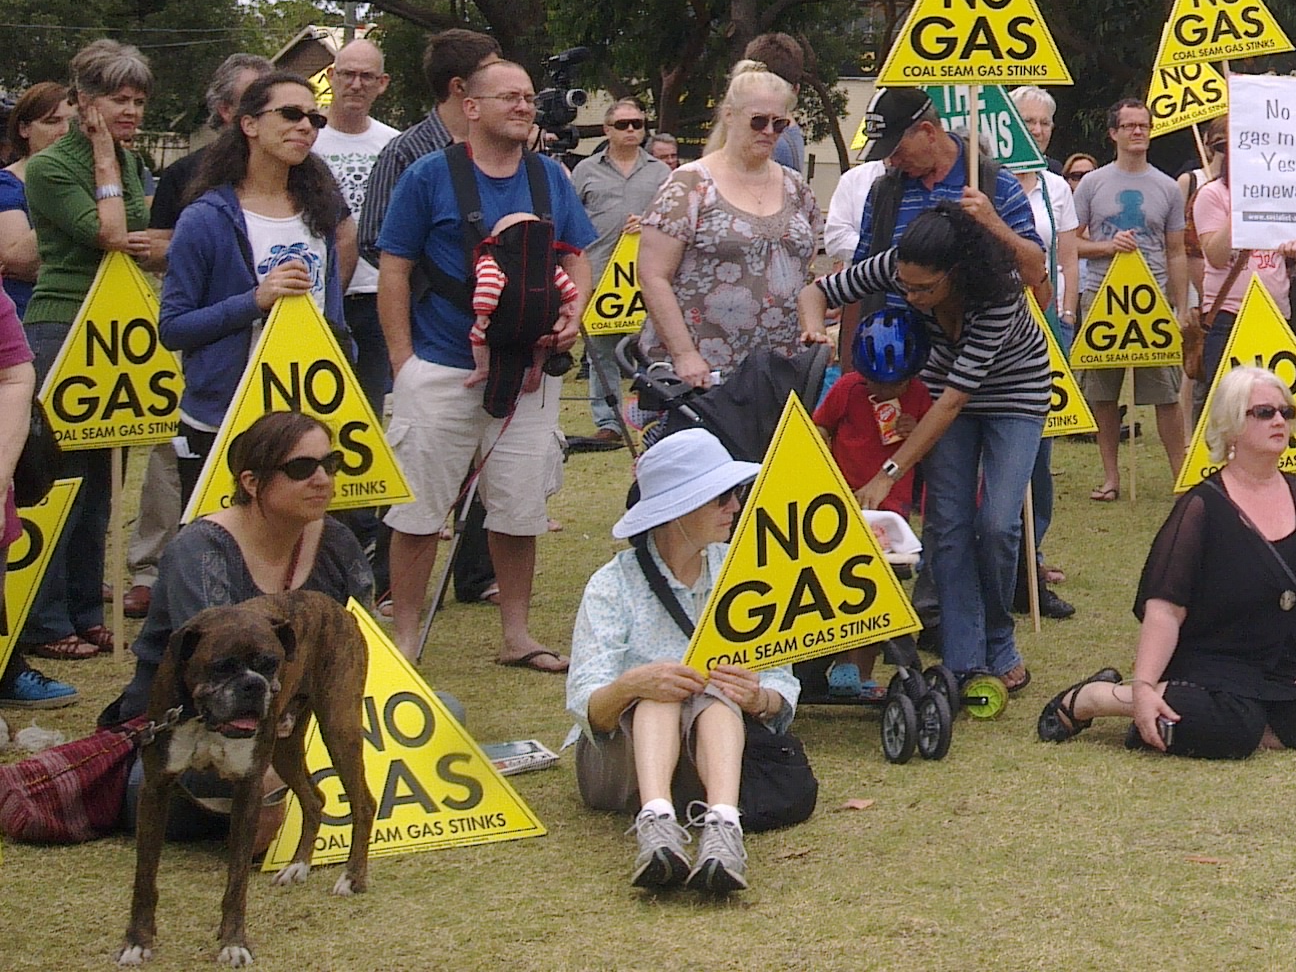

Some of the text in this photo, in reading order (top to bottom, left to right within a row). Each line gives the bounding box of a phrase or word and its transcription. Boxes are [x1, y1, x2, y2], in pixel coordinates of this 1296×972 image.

[910, 16, 1037, 61] GAS
[1174, 6, 1265, 47] GAS
[1172, 39, 1276, 61] COAL SEAM GAS STINKS
[903, 64, 1047, 77] COAL SEAM GAS STINKS
[1160, 63, 1202, 89] NO
[1150, 79, 1222, 119] GAS
[1266, 99, 1290, 120] No
[1191, 108, 1208, 119] GAS
[1237, 130, 1270, 150] gas
[1261, 152, 1296, 173] Yes
[613, 261, 635, 288] N
[595, 291, 648, 319] GA
[1106, 284, 1157, 315] NO
[591, 320, 613, 330] COAL
[614, 318, 635, 328] SEAM
[1085, 318, 1173, 351] GAS
[86, 318, 157, 367] NO
[1080, 351, 1181, 364] COAL SEAM GAS STINKS
[52, 370, 178, 424] GAS
[261, 359, 344, 414] NO
[54, 430, 77, 442] OAL
[81, 427, 115, 440] SEAM
[119, 424, 144, 437] GAS
[1047, 414, 1078, 428] STINKS
[341, 481, 386, 497] STINKS
[756, 493, 848, 567] NO
[714, 555, 877, 643] GAS
[706, 649, 750, 671] COAL
[755, 636, 798, 660] SEAM
[802, 628, 835, 648] GAS
[840, 613, 891, 637] STINKS
[314, 834, 349, 852] OAL
[366, 827, 403, 846] EAM
[406, 821, 444, 839] GAS
[449, 812, 507, 834] STINKS
